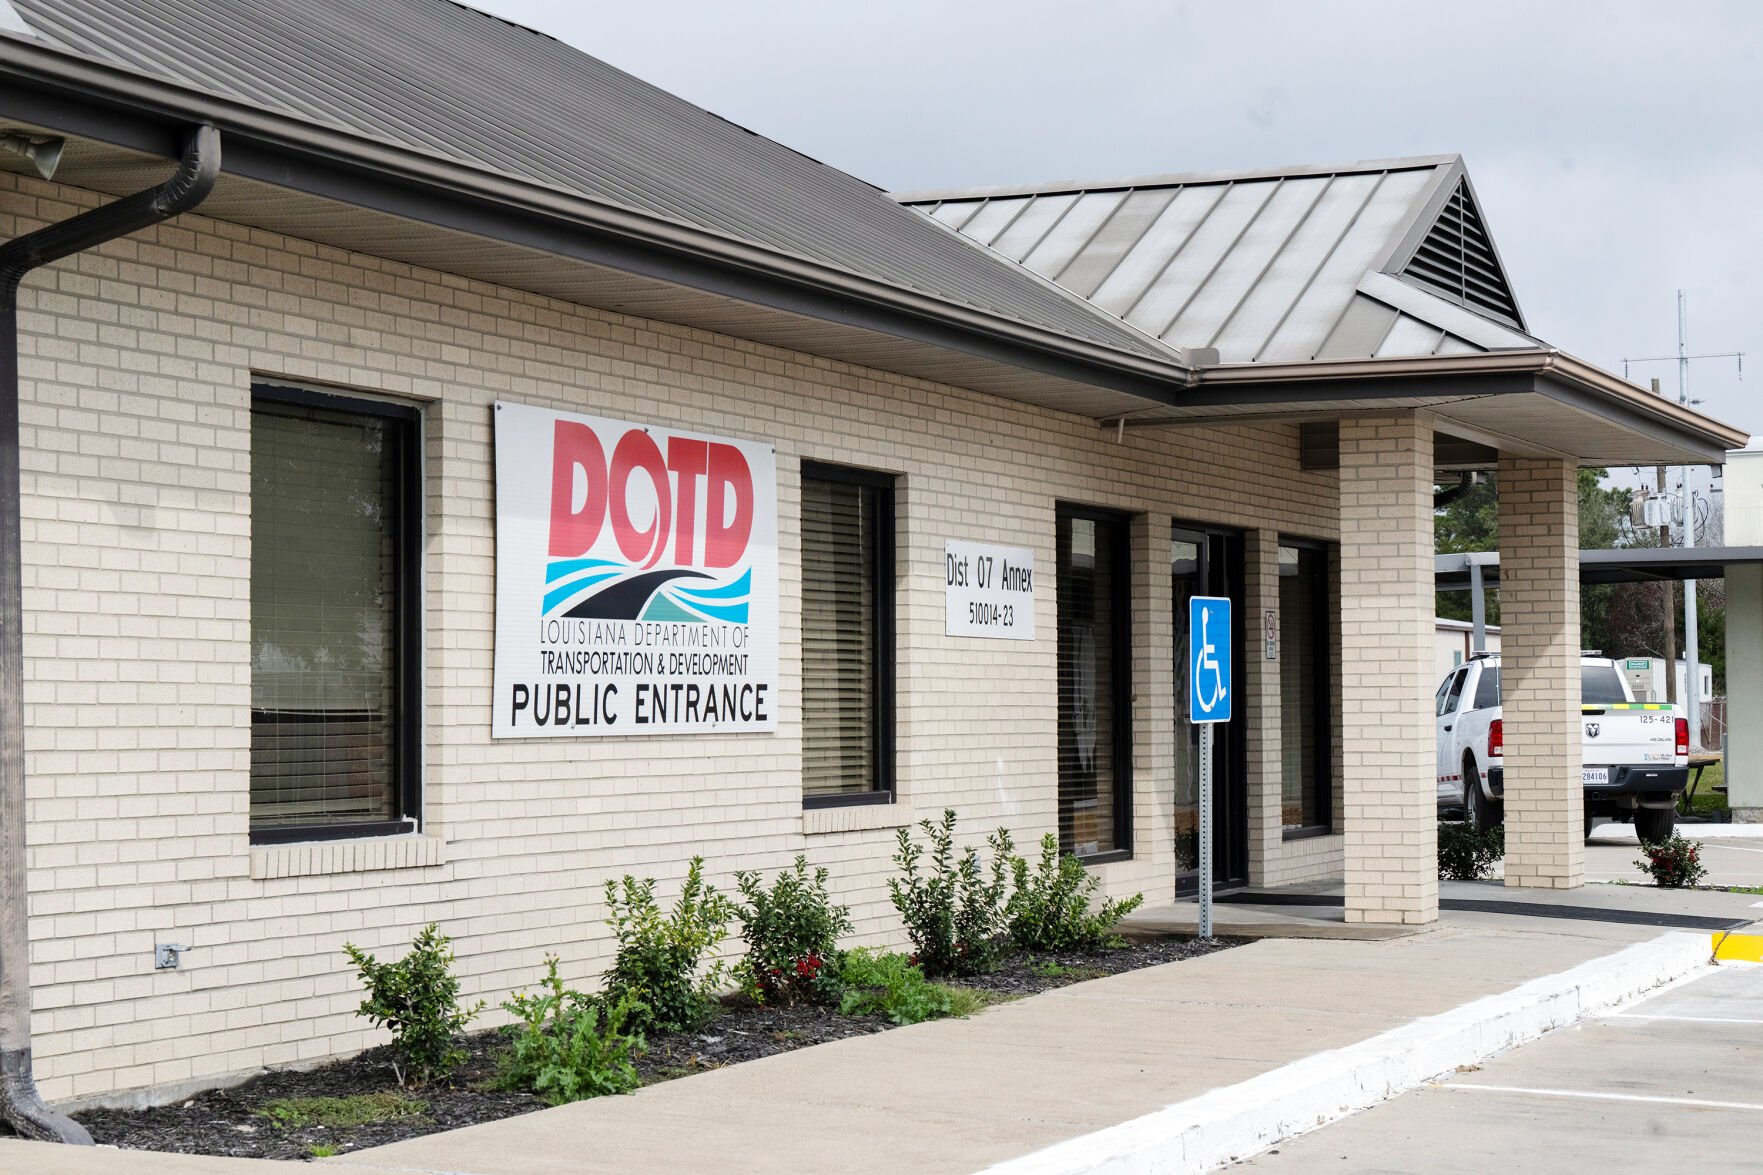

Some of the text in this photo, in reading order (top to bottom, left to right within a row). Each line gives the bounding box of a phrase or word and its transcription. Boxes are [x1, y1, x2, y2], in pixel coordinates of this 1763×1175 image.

[548, 419, 754, 571] DOTD
[947, 553, 1033, 593] Dist 07 Annex
[969, 602, 1014, 627] 510014-23
[540, 619, 749, 648] LOUISIANA DEPARTMENT OF
[541, 650, 748, 676] TRANSPORTATION & DEVELOPMENT
[511, 683, 768, 727] PUBLIC ENTRANCE
